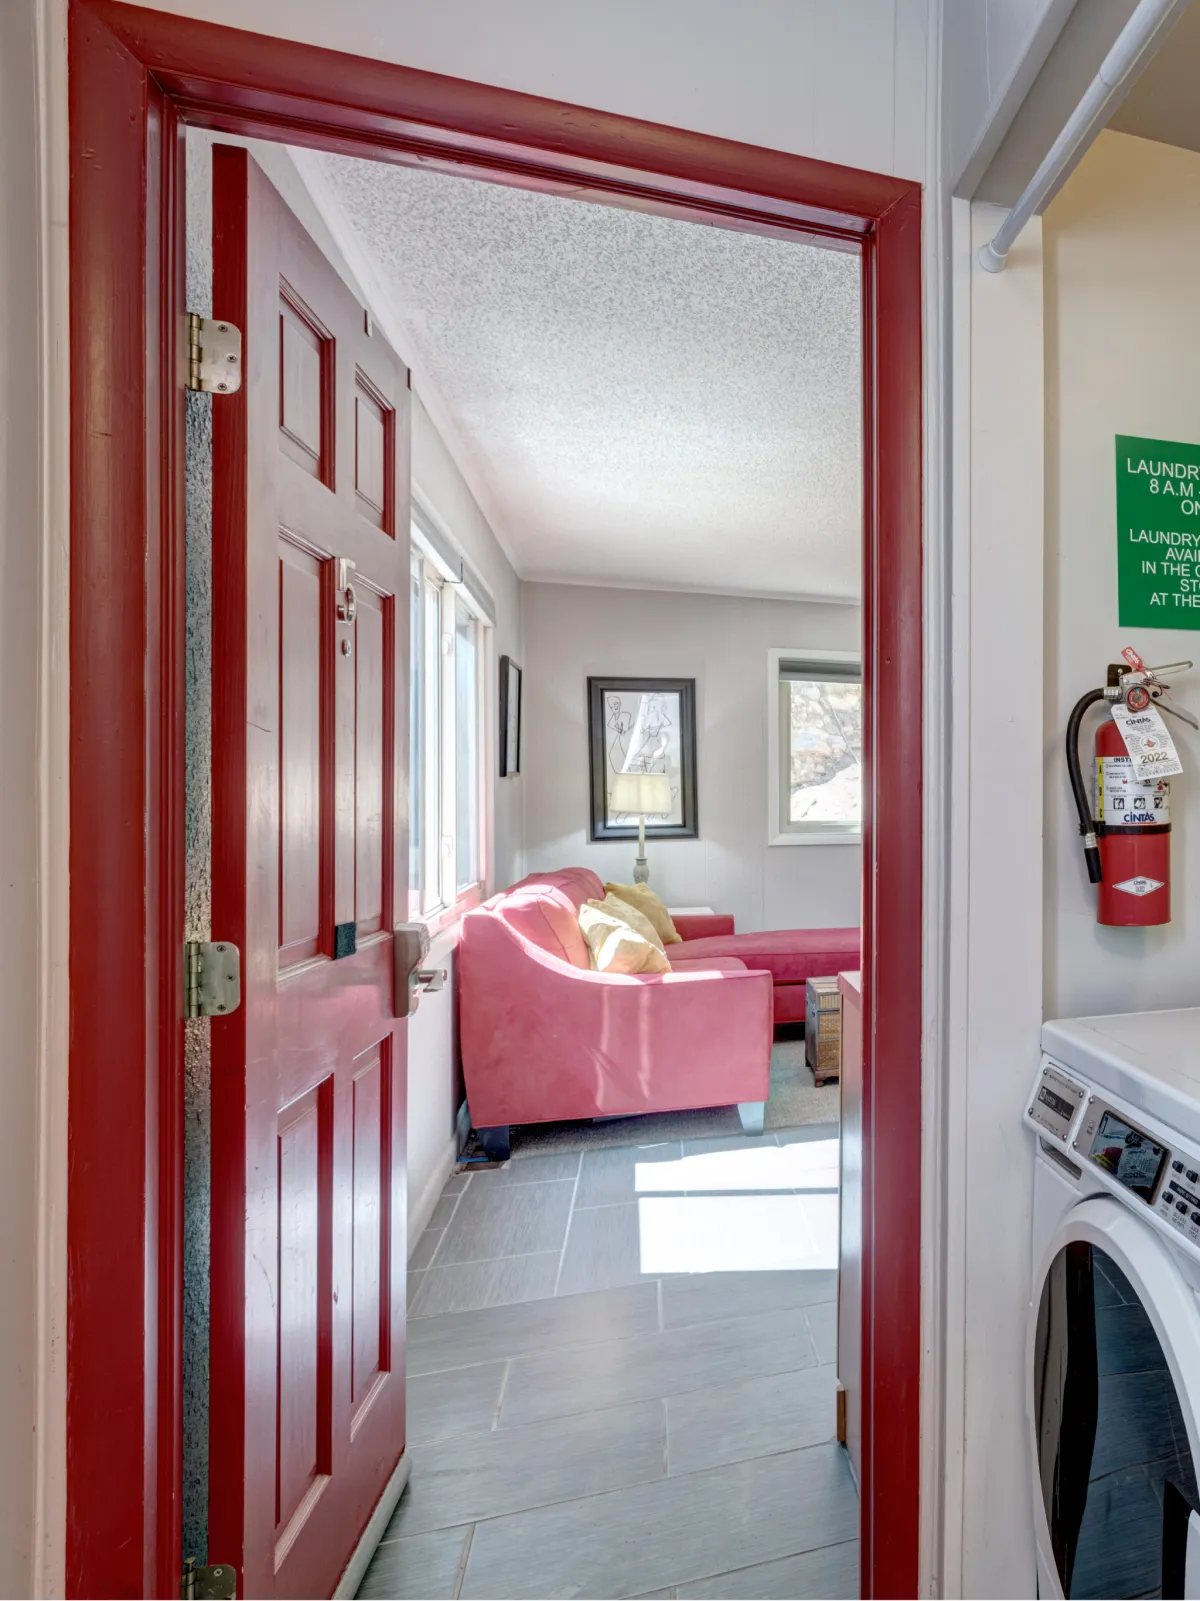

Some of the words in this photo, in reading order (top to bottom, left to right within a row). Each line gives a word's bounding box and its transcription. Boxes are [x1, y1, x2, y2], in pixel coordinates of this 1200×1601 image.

[1150, 478, 1159, 493] 8
[1163, 480, 1194, 497] A.M
[1130, 528, 1200, 547] LAUNDRY
[1142, 561, 1156, 574] IN
[1161, 562, 1190, 576] THE
[1150, 592, 1168, 606] AT
[1172, 594, 1200, 608] THE
[1140, 751, 1168, 764] 2022
